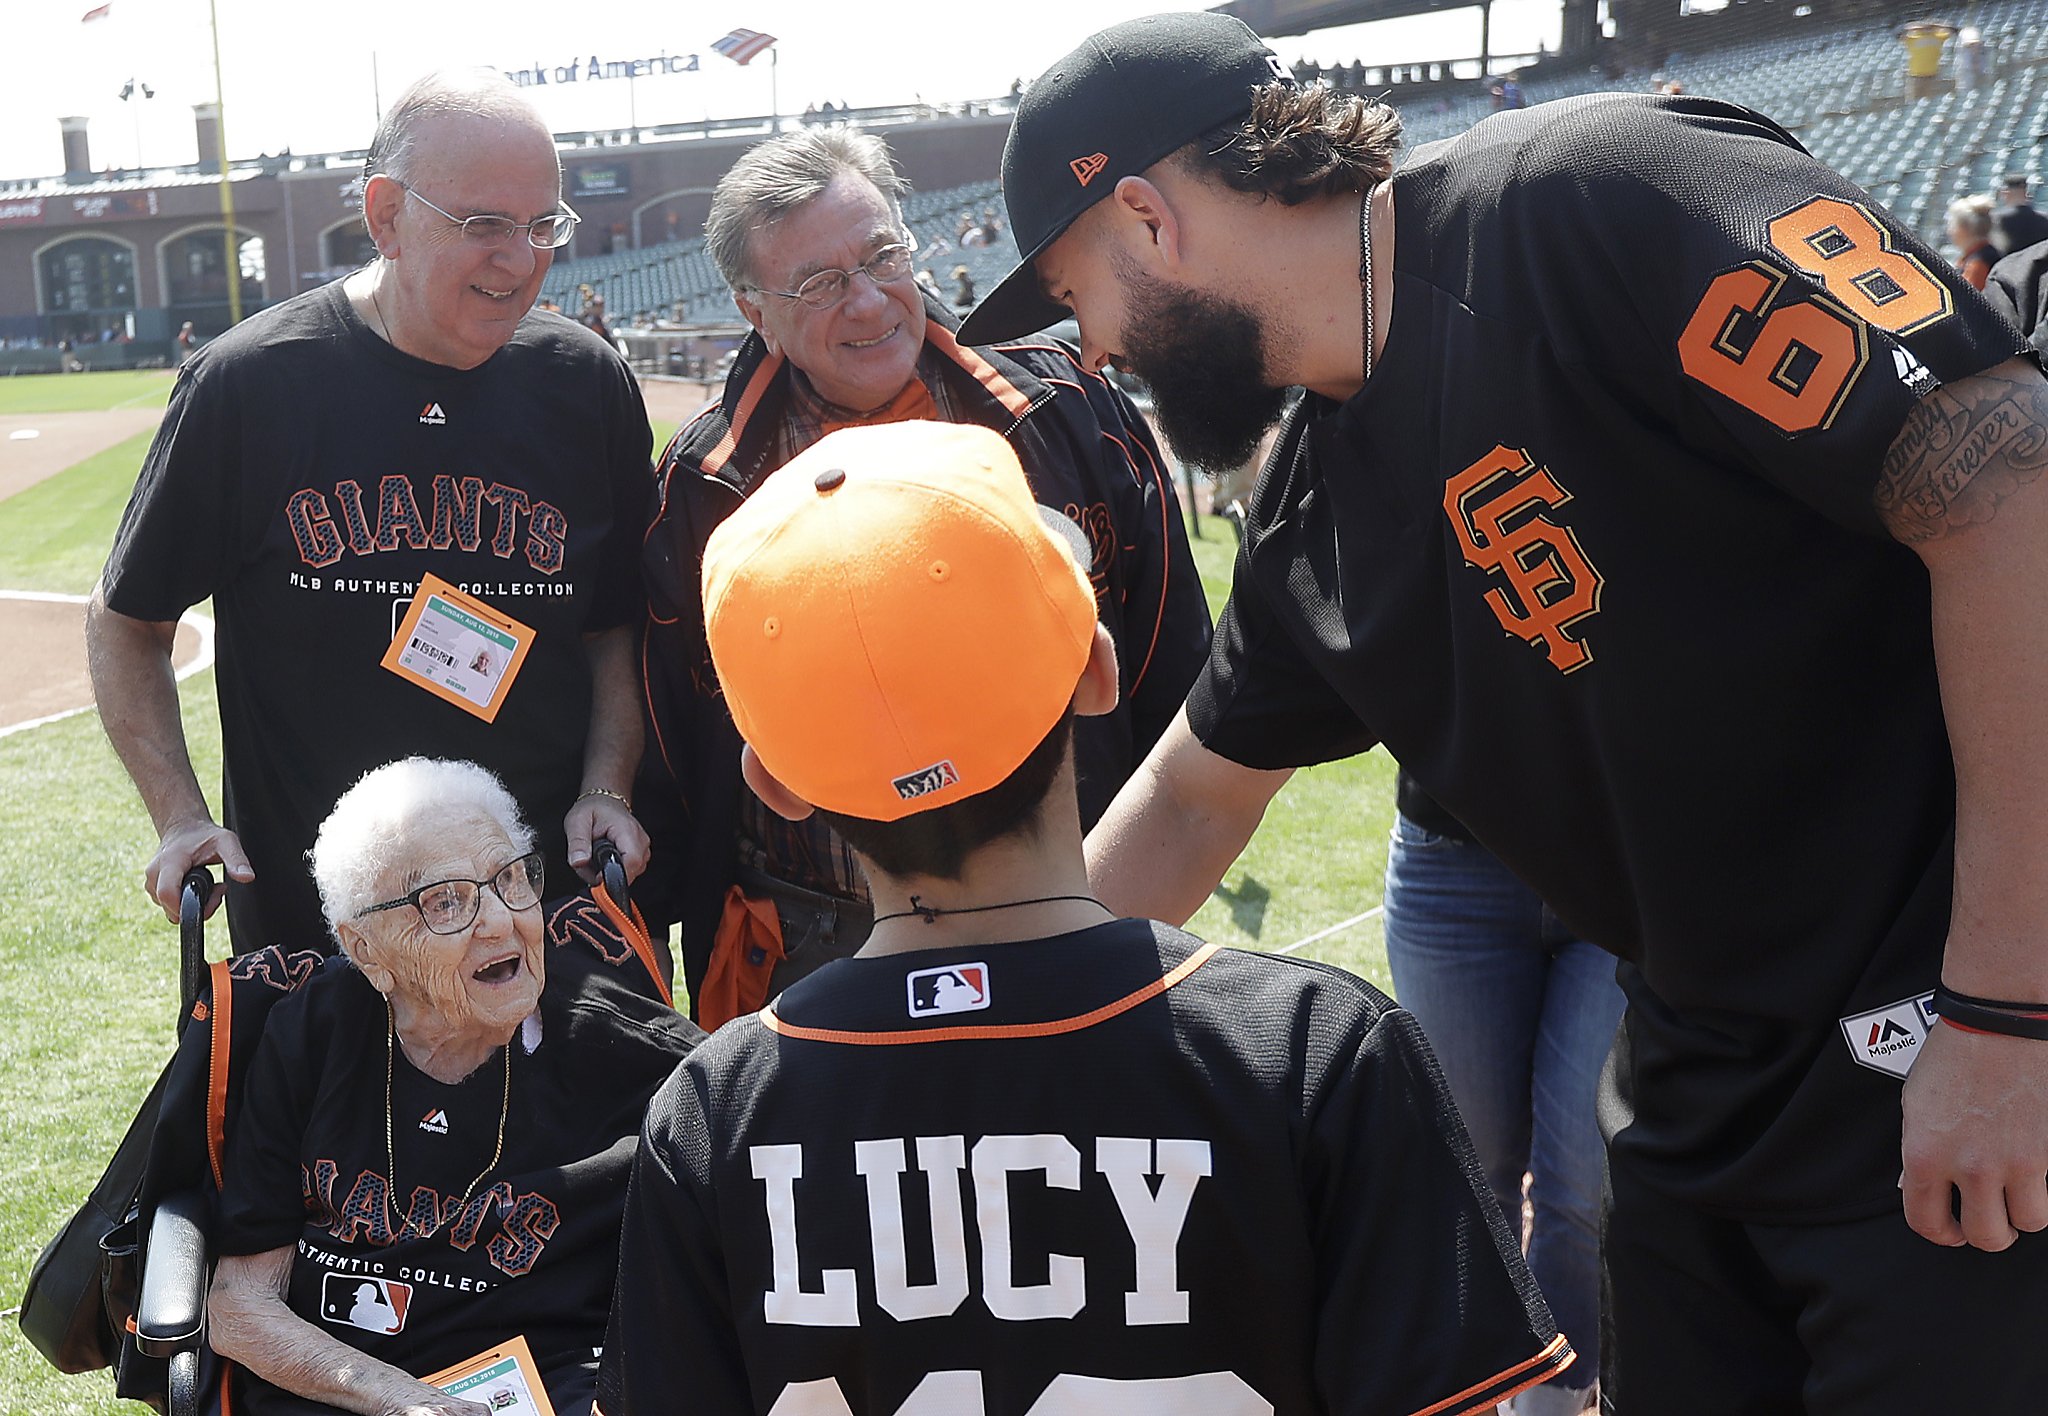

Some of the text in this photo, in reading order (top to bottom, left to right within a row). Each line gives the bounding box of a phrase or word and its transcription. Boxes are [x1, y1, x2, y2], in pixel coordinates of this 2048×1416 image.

[555, 57, 579, 84] of
[587, 54, 700, 80] America
[1676, 193, 1954, 440] 68
[285, 474, 568, 576] GIANTS
[1442, 443, 1606, 676] SF
[290, 571, 573, 596] MLB AUTHEN COLLECTION
[465, 617, 479, 628] AUG
[1868, 1034, 1918, 1058] Majestic
[749, 1133, 1213, 1327] LUCY
[298, 1238, 499, 1294] UTHENTIC COLLEC
[454, 1381, 469, 1391] AUG
